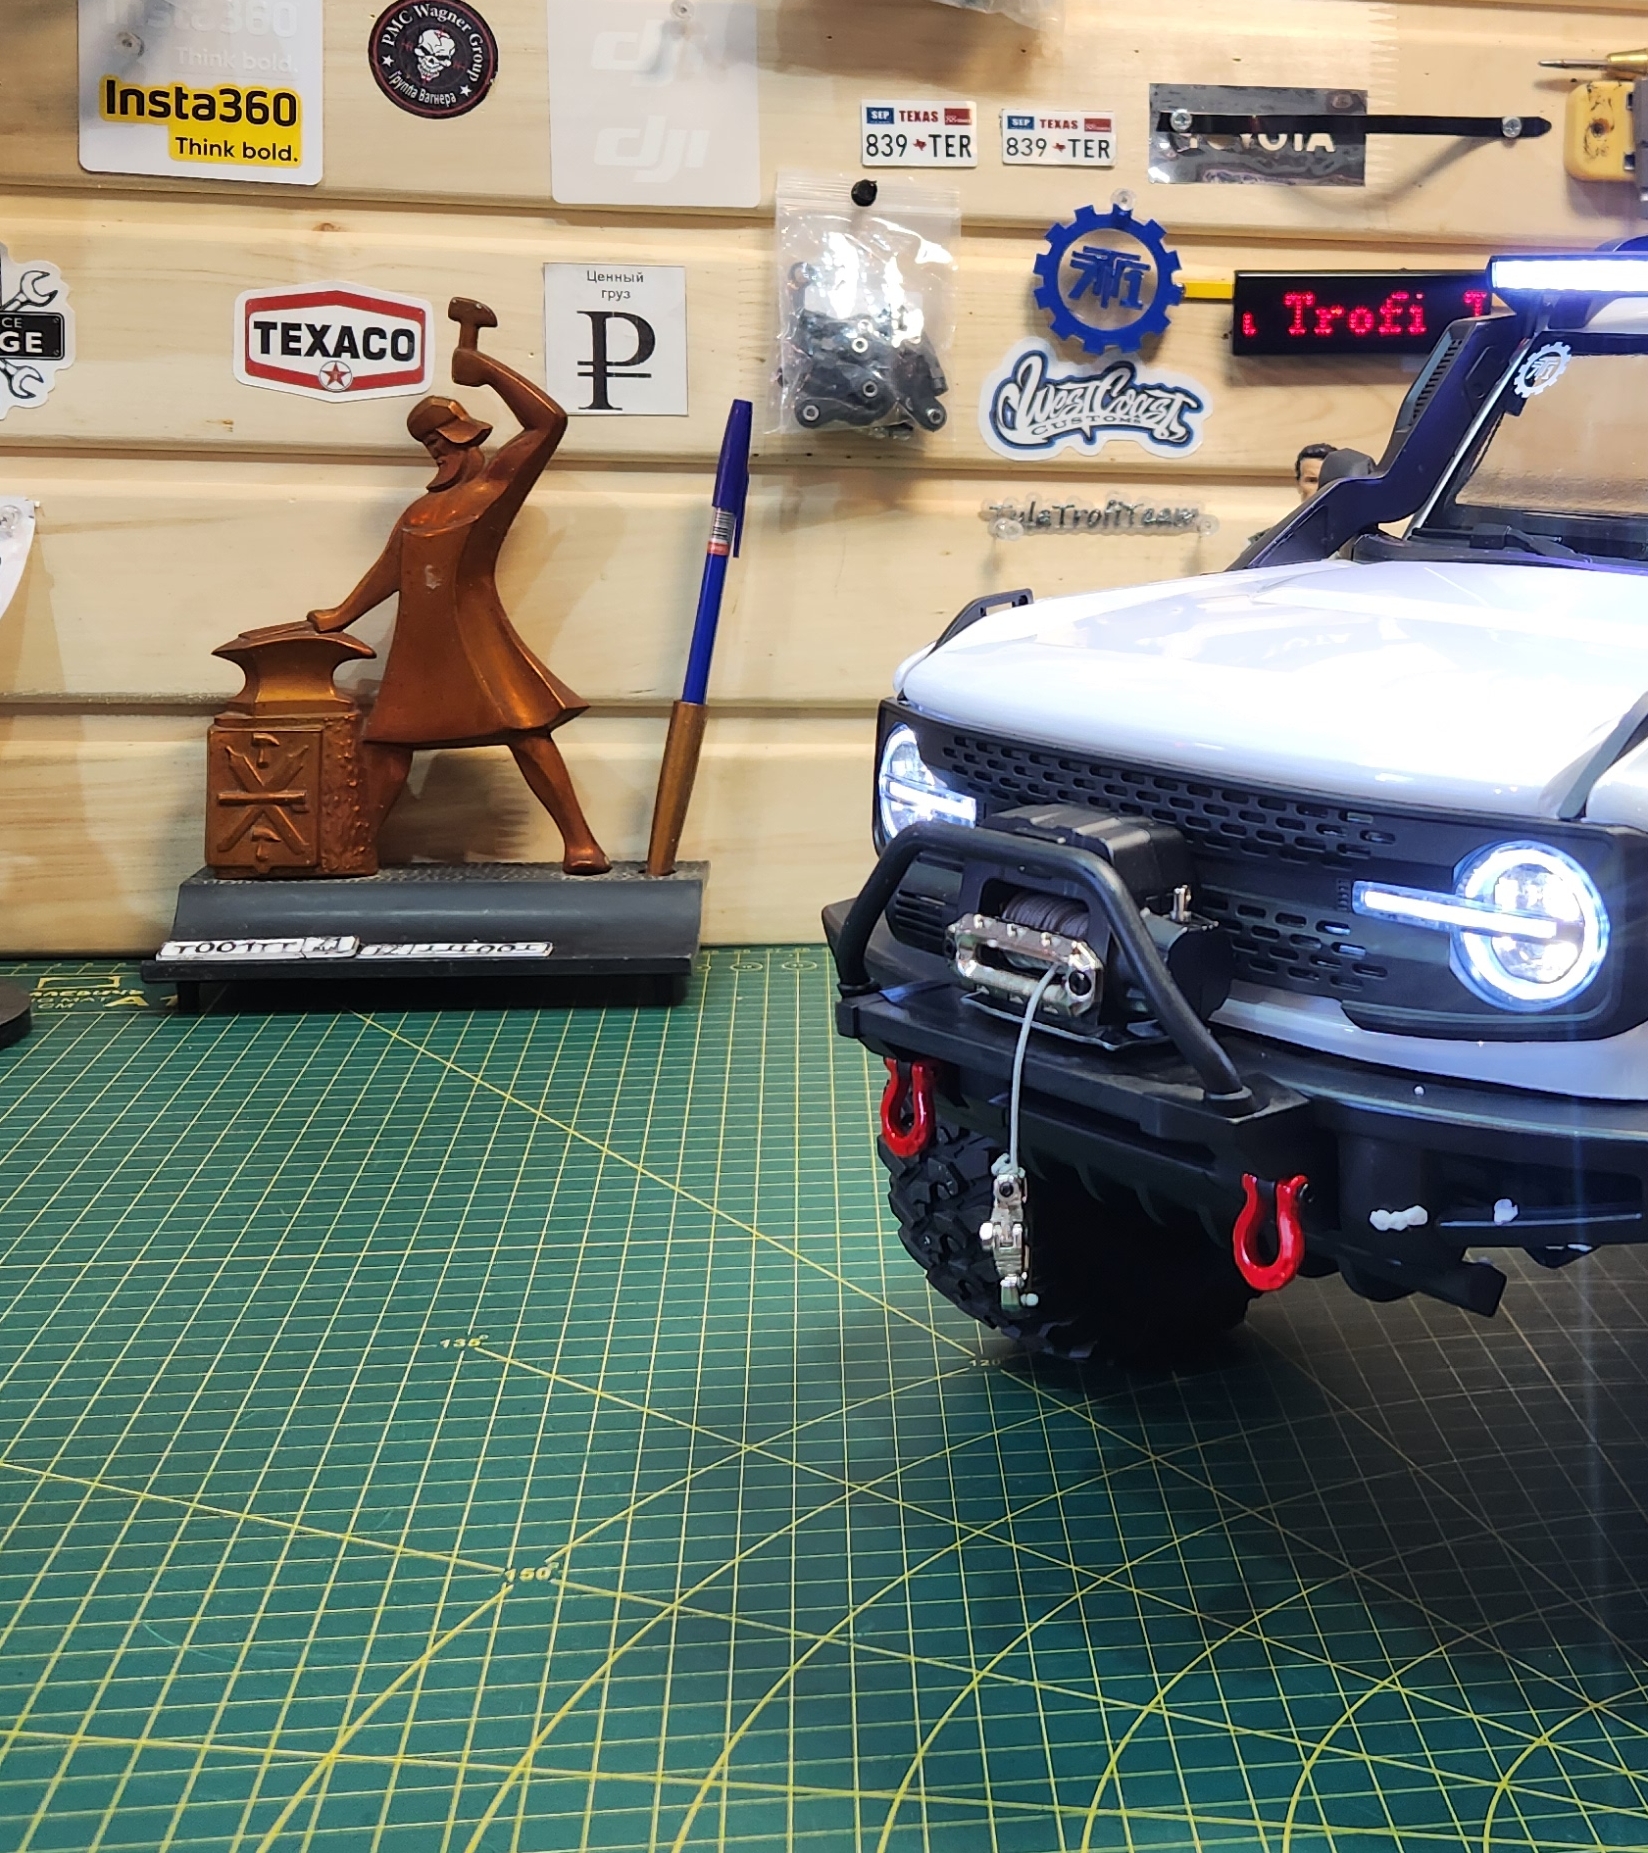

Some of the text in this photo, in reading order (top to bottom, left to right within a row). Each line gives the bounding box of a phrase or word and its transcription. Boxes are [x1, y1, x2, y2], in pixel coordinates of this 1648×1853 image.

[381, 4, 484, 82] PMC Wagner Group
[388, 70, 457, 107] Группа Вагнера
[106, 79, 298, 127] Insta360
[871, 110, 890, 120] SEP
[899, 110, 939, 123] TEXAS
[1012, 118, 1031, 127] SEP
[1039, 119, 1079, 130] TEXAS
[175, 137, 299, 163] Think bold.
[866, 133, 972, 158] 839 TER
[1006, 137, 1110, 159] 839 TER
[587, 270, 644, 283] Ценный
[601, 289, 632, 301] груз
[1283, 290, 1428, 337] Trofi
[253, 320, 416, 362] TEXACO
[1030, 414, 1142, 436] CUSTOMS
